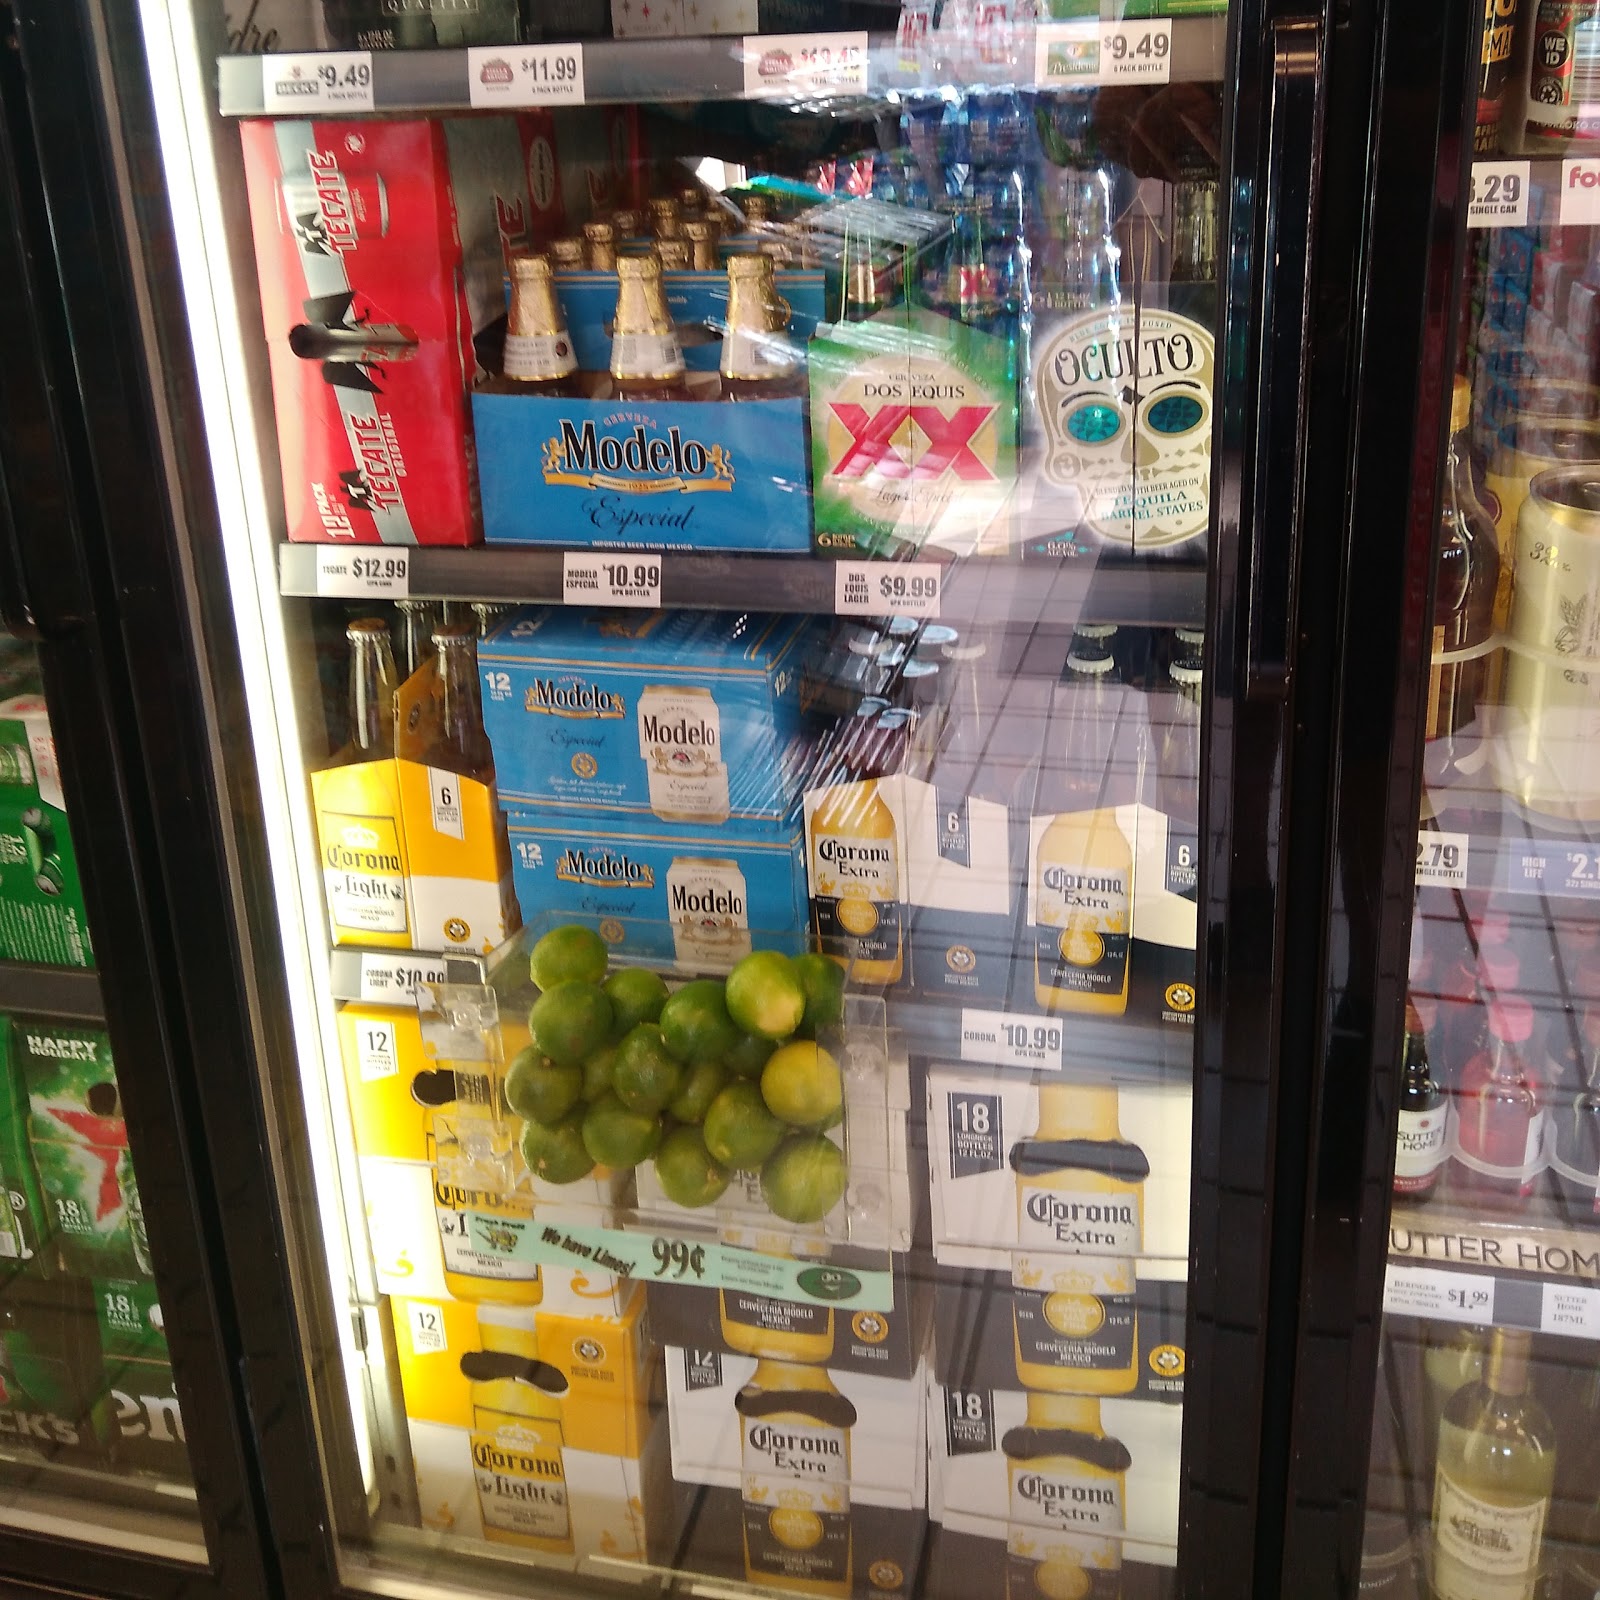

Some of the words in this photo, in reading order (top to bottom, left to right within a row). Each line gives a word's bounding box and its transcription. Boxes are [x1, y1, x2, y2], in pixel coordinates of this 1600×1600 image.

[1104, 31, 1169, 60] $9.49
[1544, 36, 1566, 52] WE
[1138, 62, 1164, 72] BOTTLE
[1545, 51, 1561, 65] ID
[318, 64, 370, 88] $9.49
[521, 56, 577, 82] $11.99
[305, 147, 359, 257] TECATE
[1470, 205, 1499, 215] SINGLE
[1500, 204, 1517, 214] CAN
[1054, 332, 1195, 387] OCULTO
[864, 383, 902, 398] DOS
[911, 384, 965, 400] EQUIS
[378, 412, 408, 478] ORIGINAL
[559, 418, 707, 476] Modelo
[348, 411, 404, 516] TECATE
[1150, 482, 1168, 493] BEER
[1168, 479, 1188, 490] AGED
[1188, 477, 1199, 486] ON
[1113, 489, 1187, 507] TEQUILA
[1156, 500, 1204, 517] STAVES
[582, 495, 700, 535] Especial
[321, 512, 356, 540] 12
[626, 541, 645, 549] BEER
[645, 542, 666, 550] FROM
[666, 542, 694, 551] MEXICO
[352, 556, 406, 579] $12.99
[567, 569, 598, 579] MODELO
[602, 563, 660, 588] $10.99
[848, 572, 866, 582] DOS
[565, 578, 599, 590] ESPECIAL
[844, 583, 869, 594] EQUIS
[880, 573, 937, 598] $9.99
[844, 594, 870, 604] LAGER
[485, 671, 511, 691] 12
[534, 677, 612, 711] Modelo
[643, 714, 716, 746] Modelo
[441, 787, 452, 806] 6
[947, 811, 959, 833] 6
[326, 845, 402, 872] Corona
[516, 842, 543, 860] 12
[819, 838, 890, 865] Corona
[1178, 845, 1191, 867] 6
[1521, 855, 1546, 868] HIGH
[565, 848, 642, 880] Modelo
[838, 862, 880, 879] Extra
[1438, 868, 1464, 879] BOTTLE
[1523, 866, 1543, 879] LIFE
[343, 873, 390, 901] Light
[1043, 865, 1124, 896] Corona
[671, 884, 743, 916] Modelo
[1063, 889, 1110, 910] Extra
[365, 968, 394, 979] CORONA
[395, 966, 445, 987] $1099
[369, 978, 389, 988] LIGHT
[1068, 979, 1092, 987] MEXICO
[1086, 974, 1112, 983] MODELO
[26, 1034, 98, 1055] HAPPY
[366, 1031, 388, 1053] 12
[963, 1030, 997, 1043] CORONA
[1001, 1021, 1062, 1051] $10.99
[28, 1046, 98, 1063] HOLIDAYS
[956, 1101, 990, 1134] 18
[1398, 1126, 1443, 1143] SUTTER
[957, 1139, 994, 1152] BOTTLES
[958, 1148, 968, 1158] 12
[1401, 1139, 1437, 1152] HOME
[55, 1198, 80, 1218] 18
[1026, 1193, 1134, 1228] Corona
[1055, 1222, 1116, 1247] Extra
[561, 1234, 592, 1258] have
[592, 1246, 637, 1279] Limes!
[651, 1236, 706, 1279] 99¢
[1390, 1228, 1504, 1266] UTTER
[1394, 1280, 1437, 1292] BERINGER
[103, 1291, 130, 1312] 18
[738, 1299, 783, 1316] CERVECERIA
[782, 1305, 814, 1320] MODELO
[1447, 1288, 1489, 1310] $1.99
[1556, 1303, 1585, 1312] HOME
[418, 1312, 437, 1332] 12
[761, 1313, 791, 1326] MEXICO
[692, 1350, 714, 1367] 12
[1035, 1341, 1083, 1354] CERVECERIA
[1083, 1345, 1116, 1357] MODELO
[1060, 1353, 1092, 1364] MEXICO
[952, 1392, 983, 1420] 18
[749, 1425, 842, 1456] Corona
[473, 1440, 562, 1479] Corona
[774, 1450, 827, 1474] Extra
[494, 1474, 547, 1502] Light
[1017, 1473, 1116, 1505] Corona
[1044, 1499, 1100, 1523] Extra
